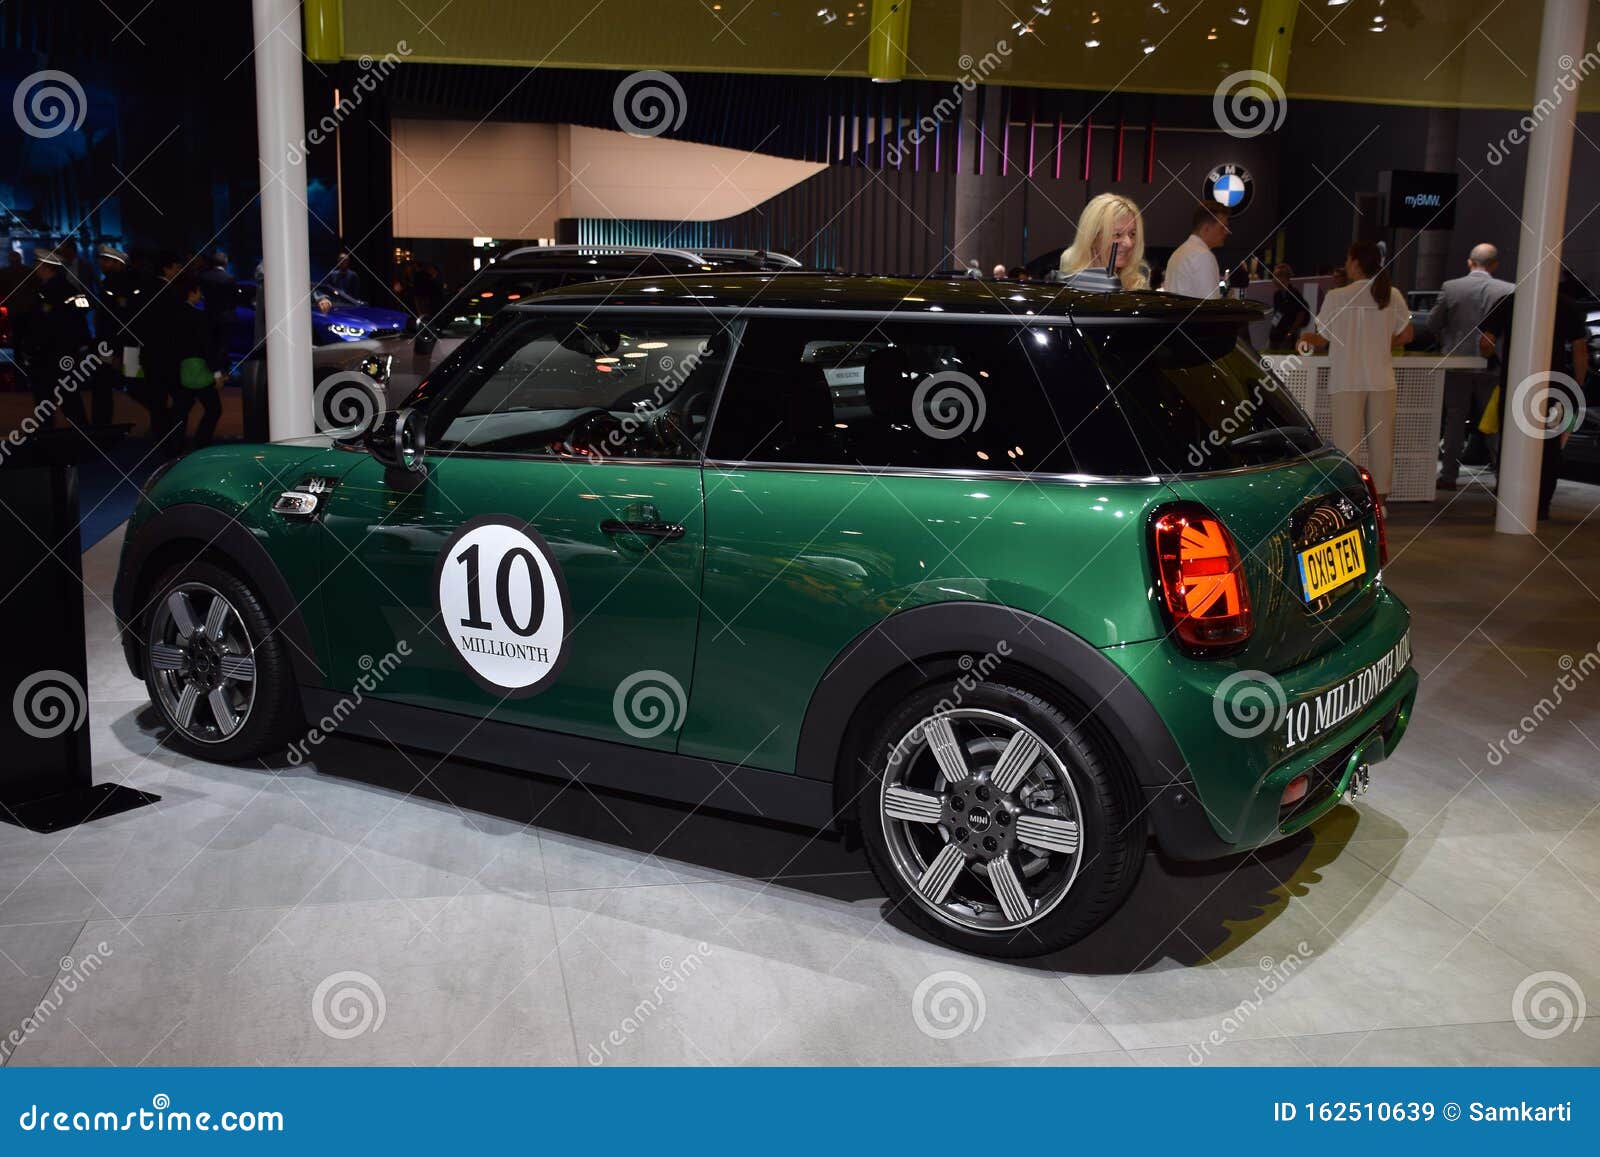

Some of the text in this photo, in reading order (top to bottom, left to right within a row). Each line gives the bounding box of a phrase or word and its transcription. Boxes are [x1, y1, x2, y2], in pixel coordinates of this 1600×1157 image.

[456, 543, 545, 637] 10
[1308, 535, 1360, 590] OX19 TEN
[460, 635, 550, 664] MILLIONTH
[1286, 702, 1310, 748] 10
[1314, 648, 1394, 735] MILLIONTH
[969, 814, 988, 825] MINI
